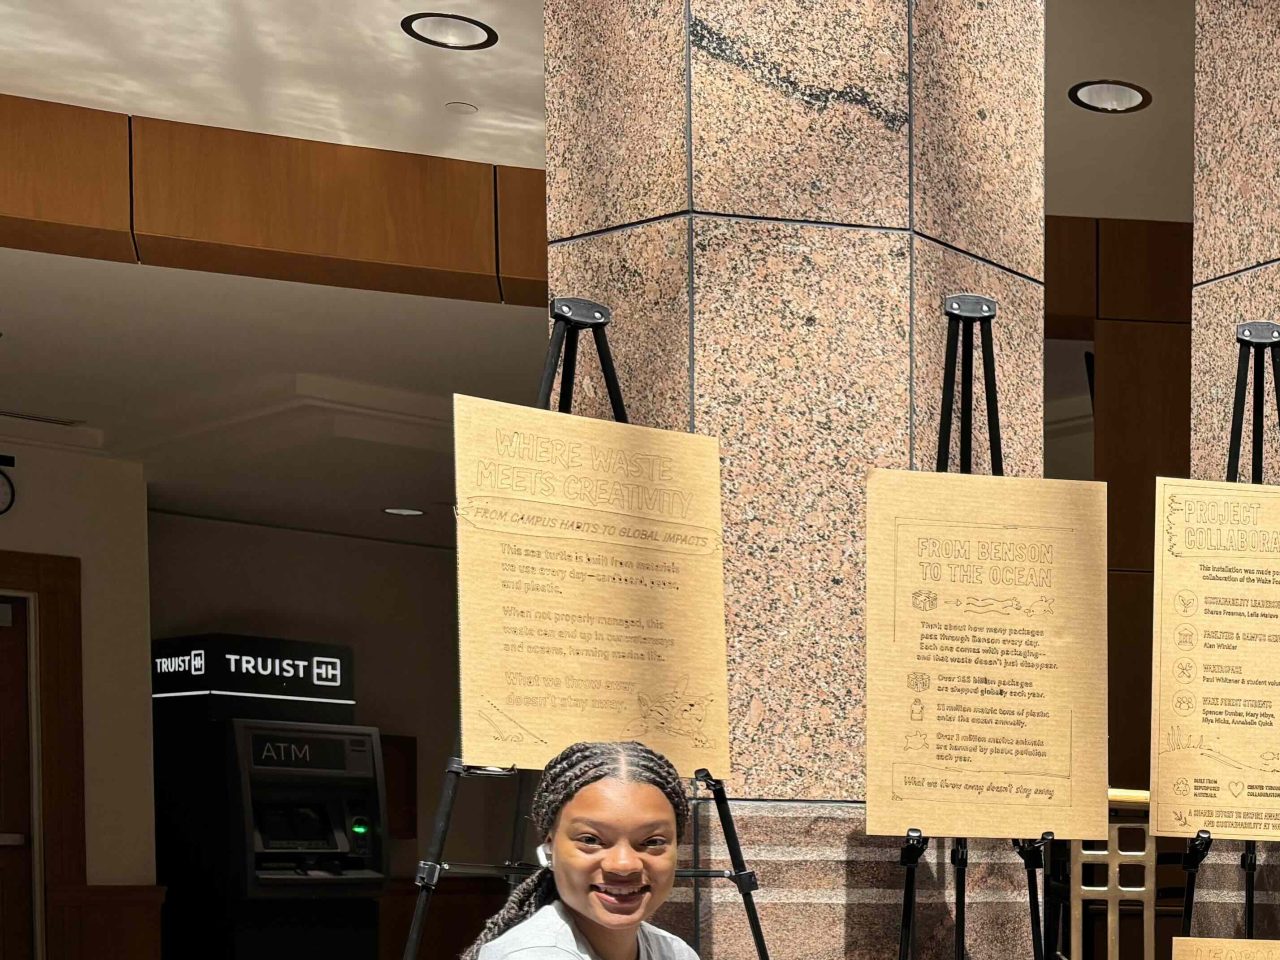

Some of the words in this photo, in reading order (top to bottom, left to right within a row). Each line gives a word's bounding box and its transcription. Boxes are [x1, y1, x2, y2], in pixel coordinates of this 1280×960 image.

[496, 428, 582, 470] WHERE
[591, 445, 673, 481] WASTE
[477, 460, 554, 496] MEETS
[564, 475, 694, 518] CREATIVITY
[1184, 500, 1260, 525] PROJECT
[474, 507, 507, 521] FROM
[511, 513, 557, 528] CAMPUS
[561, 519, 599, 533] HABITS
[602, 525, 618, 536] TO
[619, 527, 659, 541] GLOBAL
[663, 533, 708, 547] IMPACTS
[500, 543, 522, 556] This
[544, 549, 572, 562] turtle
[575, 553, 583, 561] is
[585, 553, 608, 565] built
[612, 557, 633, 568] from
[918, 538, 970, 560] FROM
[978, 541, 1053, 564] BENSON
[502, 563, 515, 572] we
[520, 565, 536, 574] use
[540, 567, 567, 579] every
[919, 562, 941, 581] TO
[948, 564, 983, 584] THE
[989, 566, 1052, 587] OCEAN
[1200, 564, 1211, 572] This
[1212, 565, 1242, 574] installation
[1256, 568, 1271, 576] made
[502, 579, 521, 589] and
[1202, 574, 1238, 583] collaboration
[1256, 577, 1271, 585] Wake
[502, 606, 531, 618] When
[535, 609, 551, 620] not
[554, 612, 594, 626] properly
[647, 618, 664, 629] this
[537, 629, 553, 637] can
[558, 629, 576, 639] end
[580, 632, 592, 642] up
[595, 630, 604, 640] in
[921, 621, 942, 630] Think
[944, 623, 966, 631] about
[986, 627, 1006, 635] many
[1009, 628, 1044, 637] packages
[920, 633, 938, 641] pass
[940, 634, 970, 643] through
[1002, 638, 1023, 647] every
[1025, 639, 1040, 648] day.
[920, 643, 938, 651] Each
[956, 646, 980, 654] comes
[982, 647, 998, 655] with
[504, 642, 524, 652] and
[569, 646, 610, 660] harming
[156, 656, 190, 674] TRUIST
[226, 654, 308, 678] TRUIST
[917, 653, 931, 661] and
[933, 654, 948, 662] that
[974, 657, 1002, 666] doesn't
[1004, 659, 1018, 668] just
[1020, 661, 1058, 670] disappear.
[505, 671, 540, 687] What
[543, 677, 562, 688] we
[565, 675, 602, 690] throw
[1247, 678, 1266, 686] student
[506, 692, 556, 708] doesn't
[559, 695, 587, 712] stay
[262, 742, 310, 761] ATM
